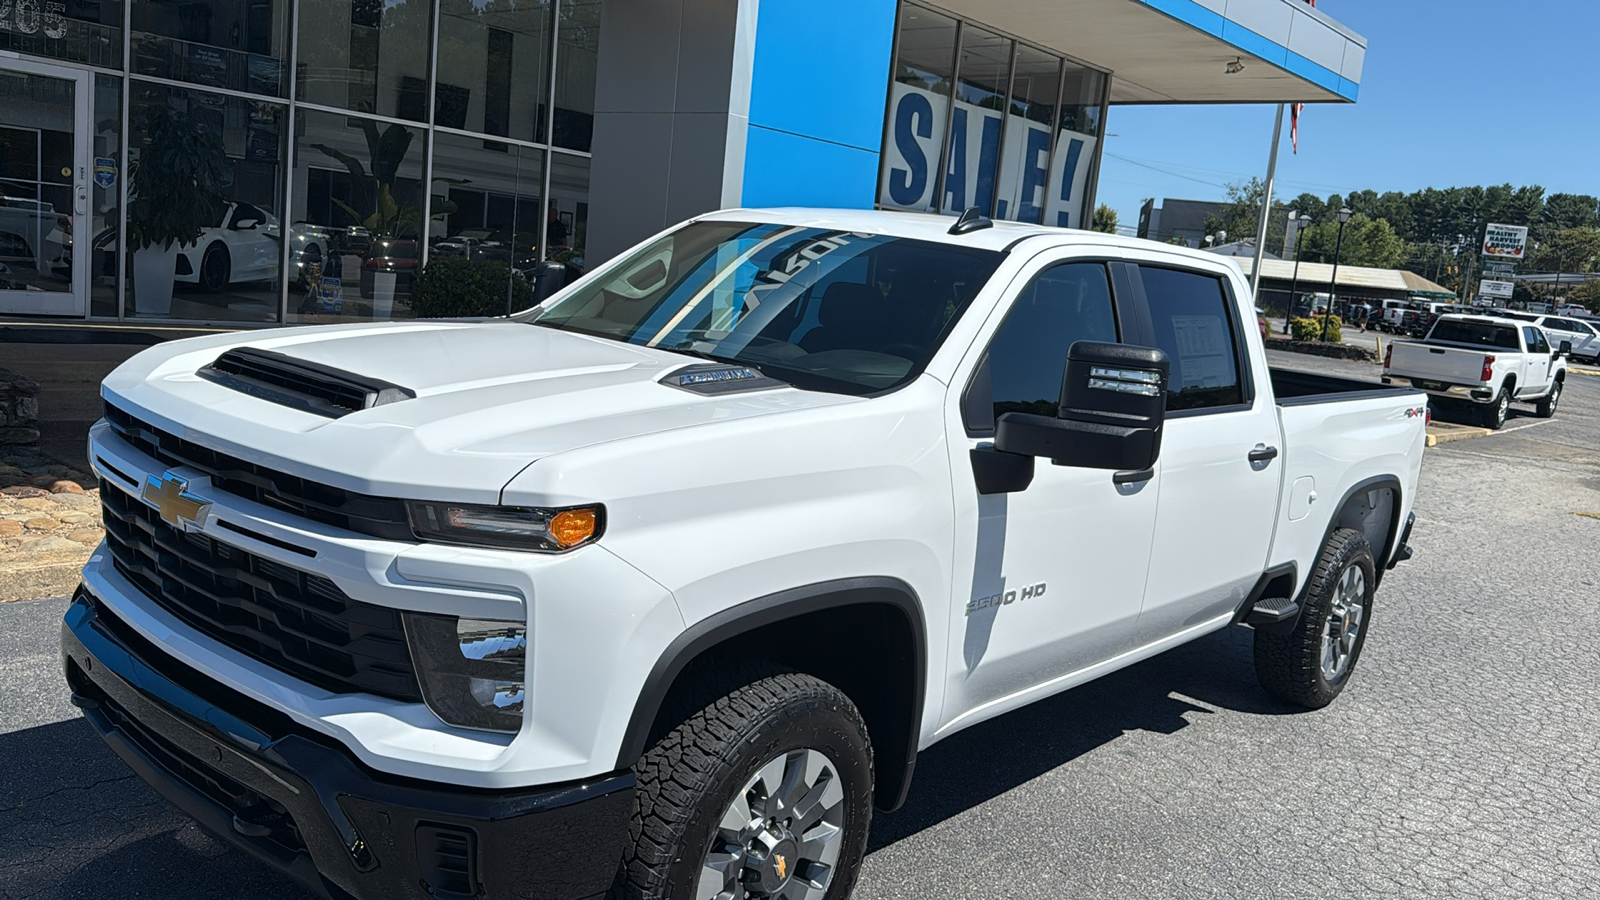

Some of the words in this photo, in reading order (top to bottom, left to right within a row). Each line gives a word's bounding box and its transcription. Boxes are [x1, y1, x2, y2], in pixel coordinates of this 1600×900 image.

[889, 92, 1084, 228] SALE!
[1487, 229, 1518, 238] HEALTHY
[1489, 236, 1522, 244] HARVEST
[1490, 242, 1524, 250] PRODUCE
[965, 590, 1016, 616] 2500
[1020, 583, 1046, 601] HD
